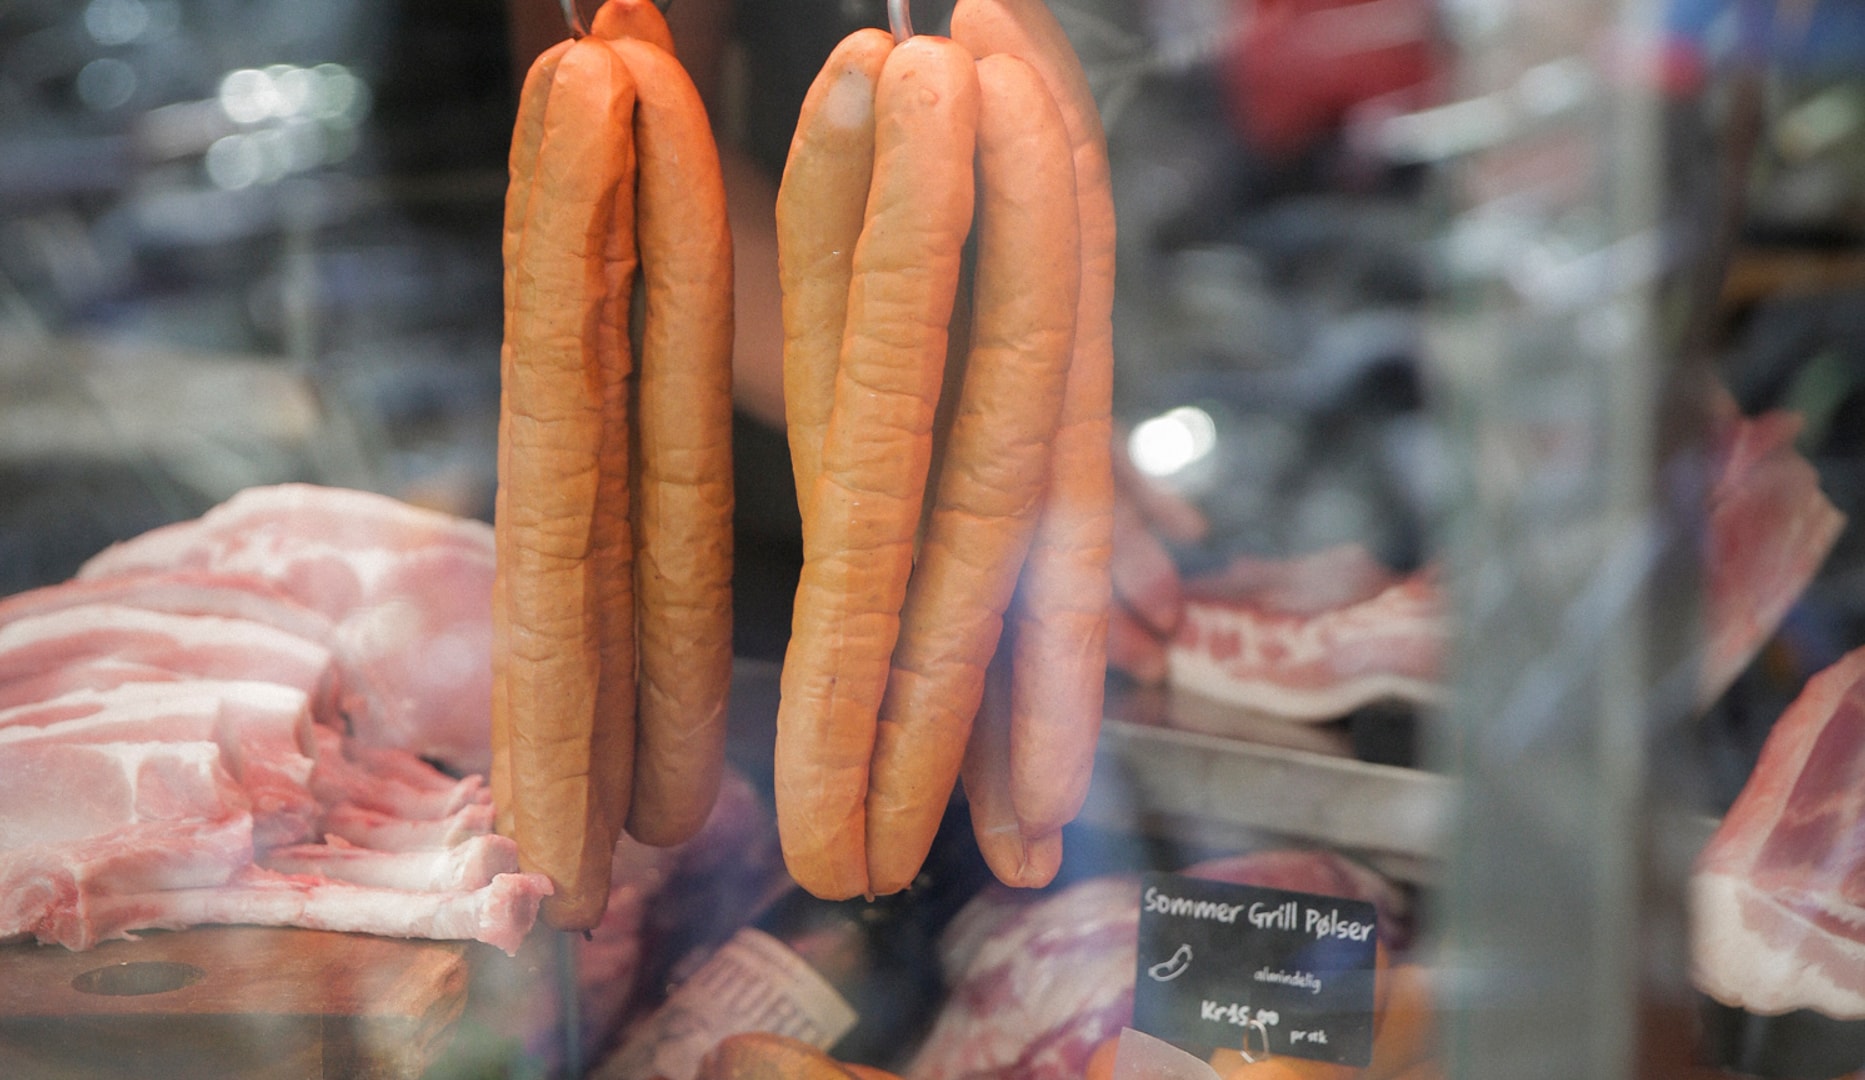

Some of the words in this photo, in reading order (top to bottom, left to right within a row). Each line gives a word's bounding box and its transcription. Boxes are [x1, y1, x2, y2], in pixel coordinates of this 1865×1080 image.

[1145, 887, 1244, 923] Sommer
[1248, 901, 1298, 930] Grill
[1306, 909, 1374, 941] Pølser
